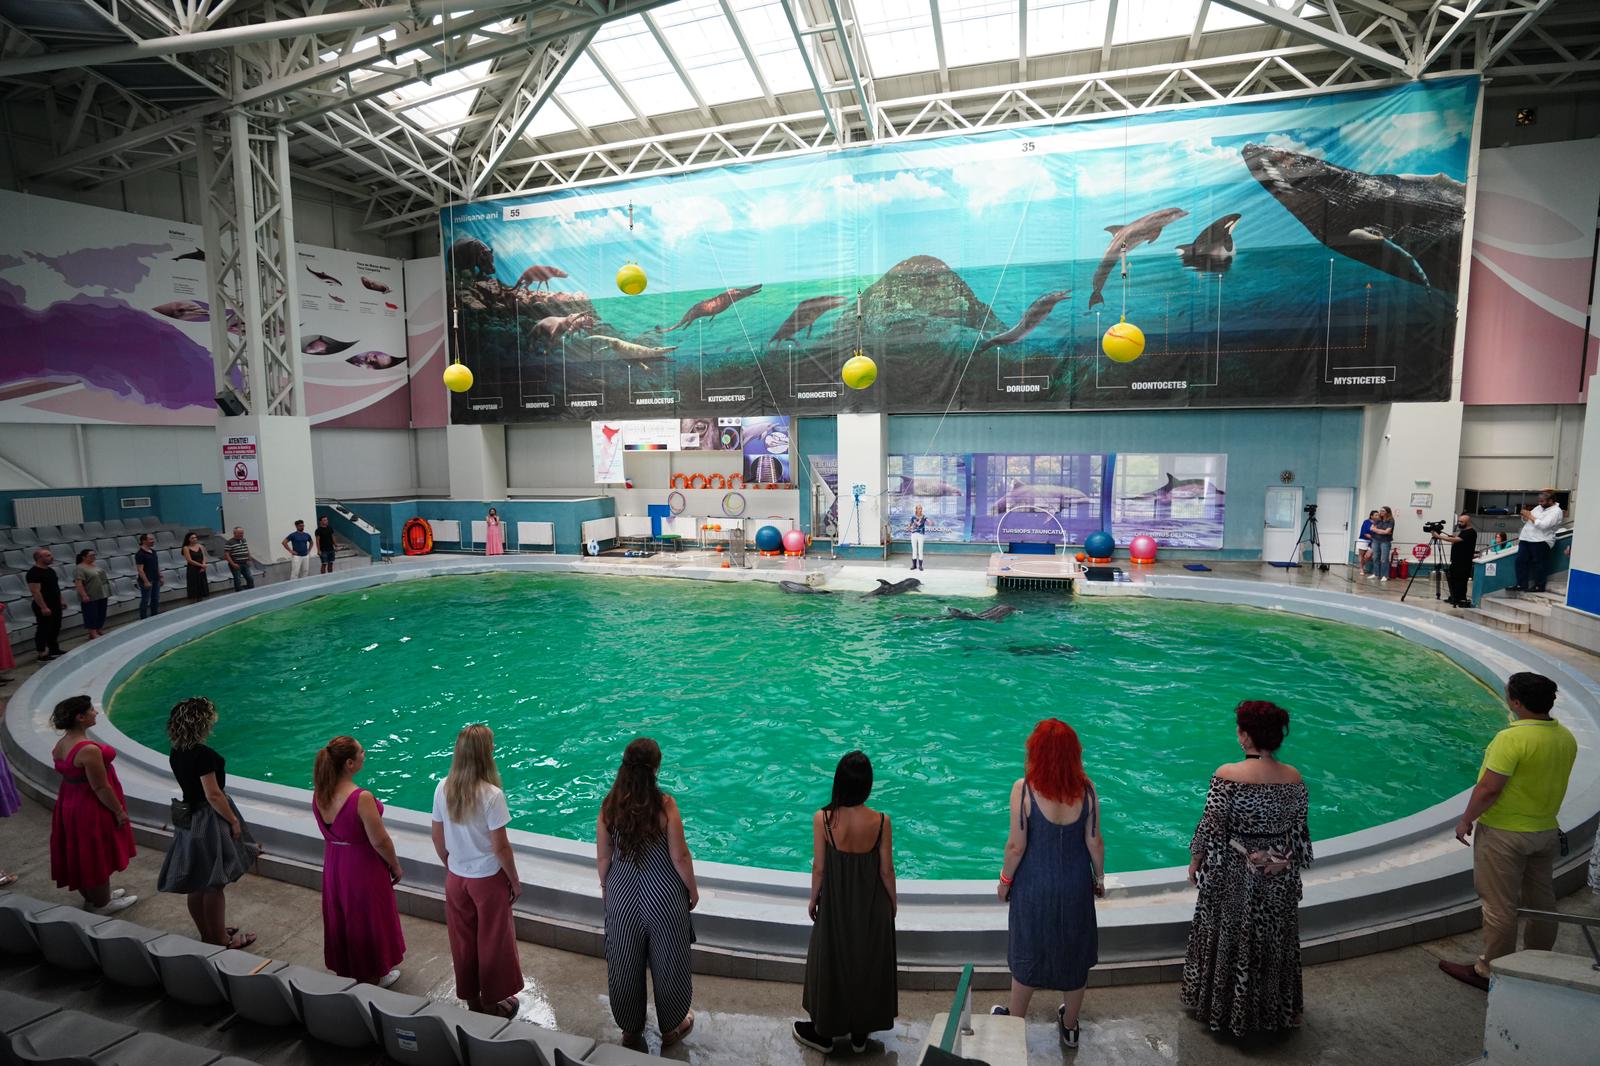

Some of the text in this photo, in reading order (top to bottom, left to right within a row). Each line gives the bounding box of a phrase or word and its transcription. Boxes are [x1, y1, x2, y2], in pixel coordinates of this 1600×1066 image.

[1022, 141, 1035, 152] 35
[510, 209, 520, 217] 55
[1333, 375, 1386, 385] MYSTICETES
[1006, 384, 1040, 393] DORUDON
[1131, 380, 1187, 390] ODONTOCETES
[707, 394, 746, 403] KUTCHICETUS
[797, 391, 838, 399] RODHOCETUS
[570, 400, 598, 408] PAKICETUS
[635, 397, 675, 405] AMBULOCETUS
